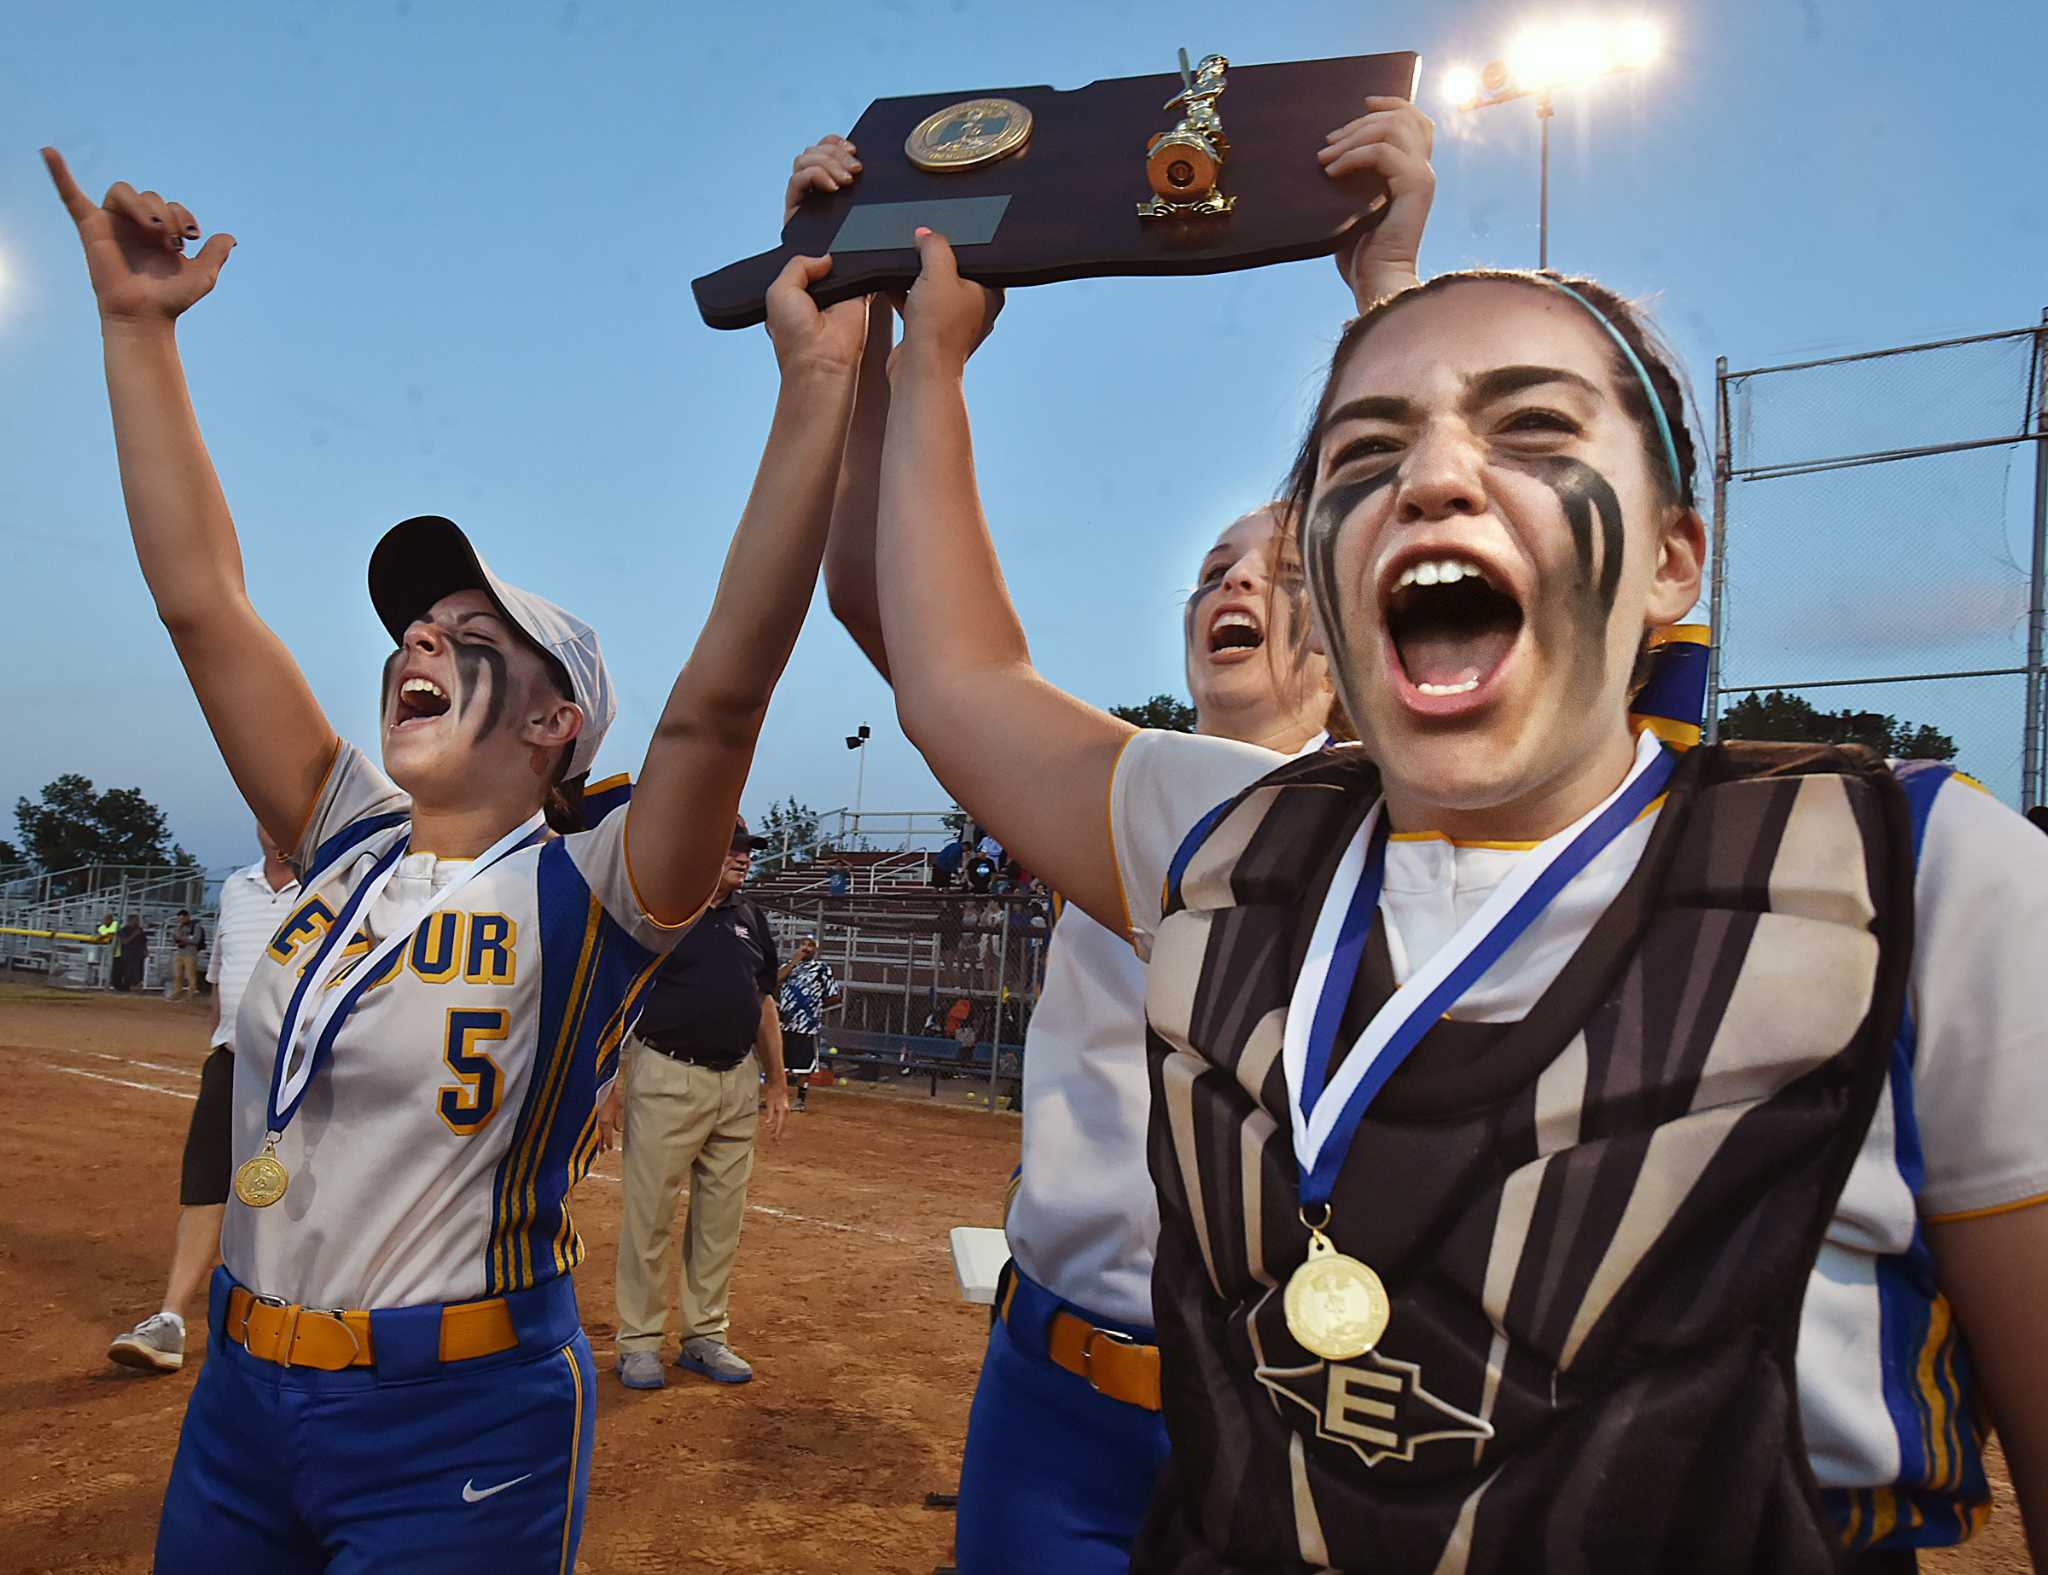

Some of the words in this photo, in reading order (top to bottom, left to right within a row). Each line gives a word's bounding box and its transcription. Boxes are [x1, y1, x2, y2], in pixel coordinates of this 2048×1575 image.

[266, 893, 517, 990] EUR
[436, 1007, 511, 1136] 5
[1324, 1363, 1402, 1449] E
